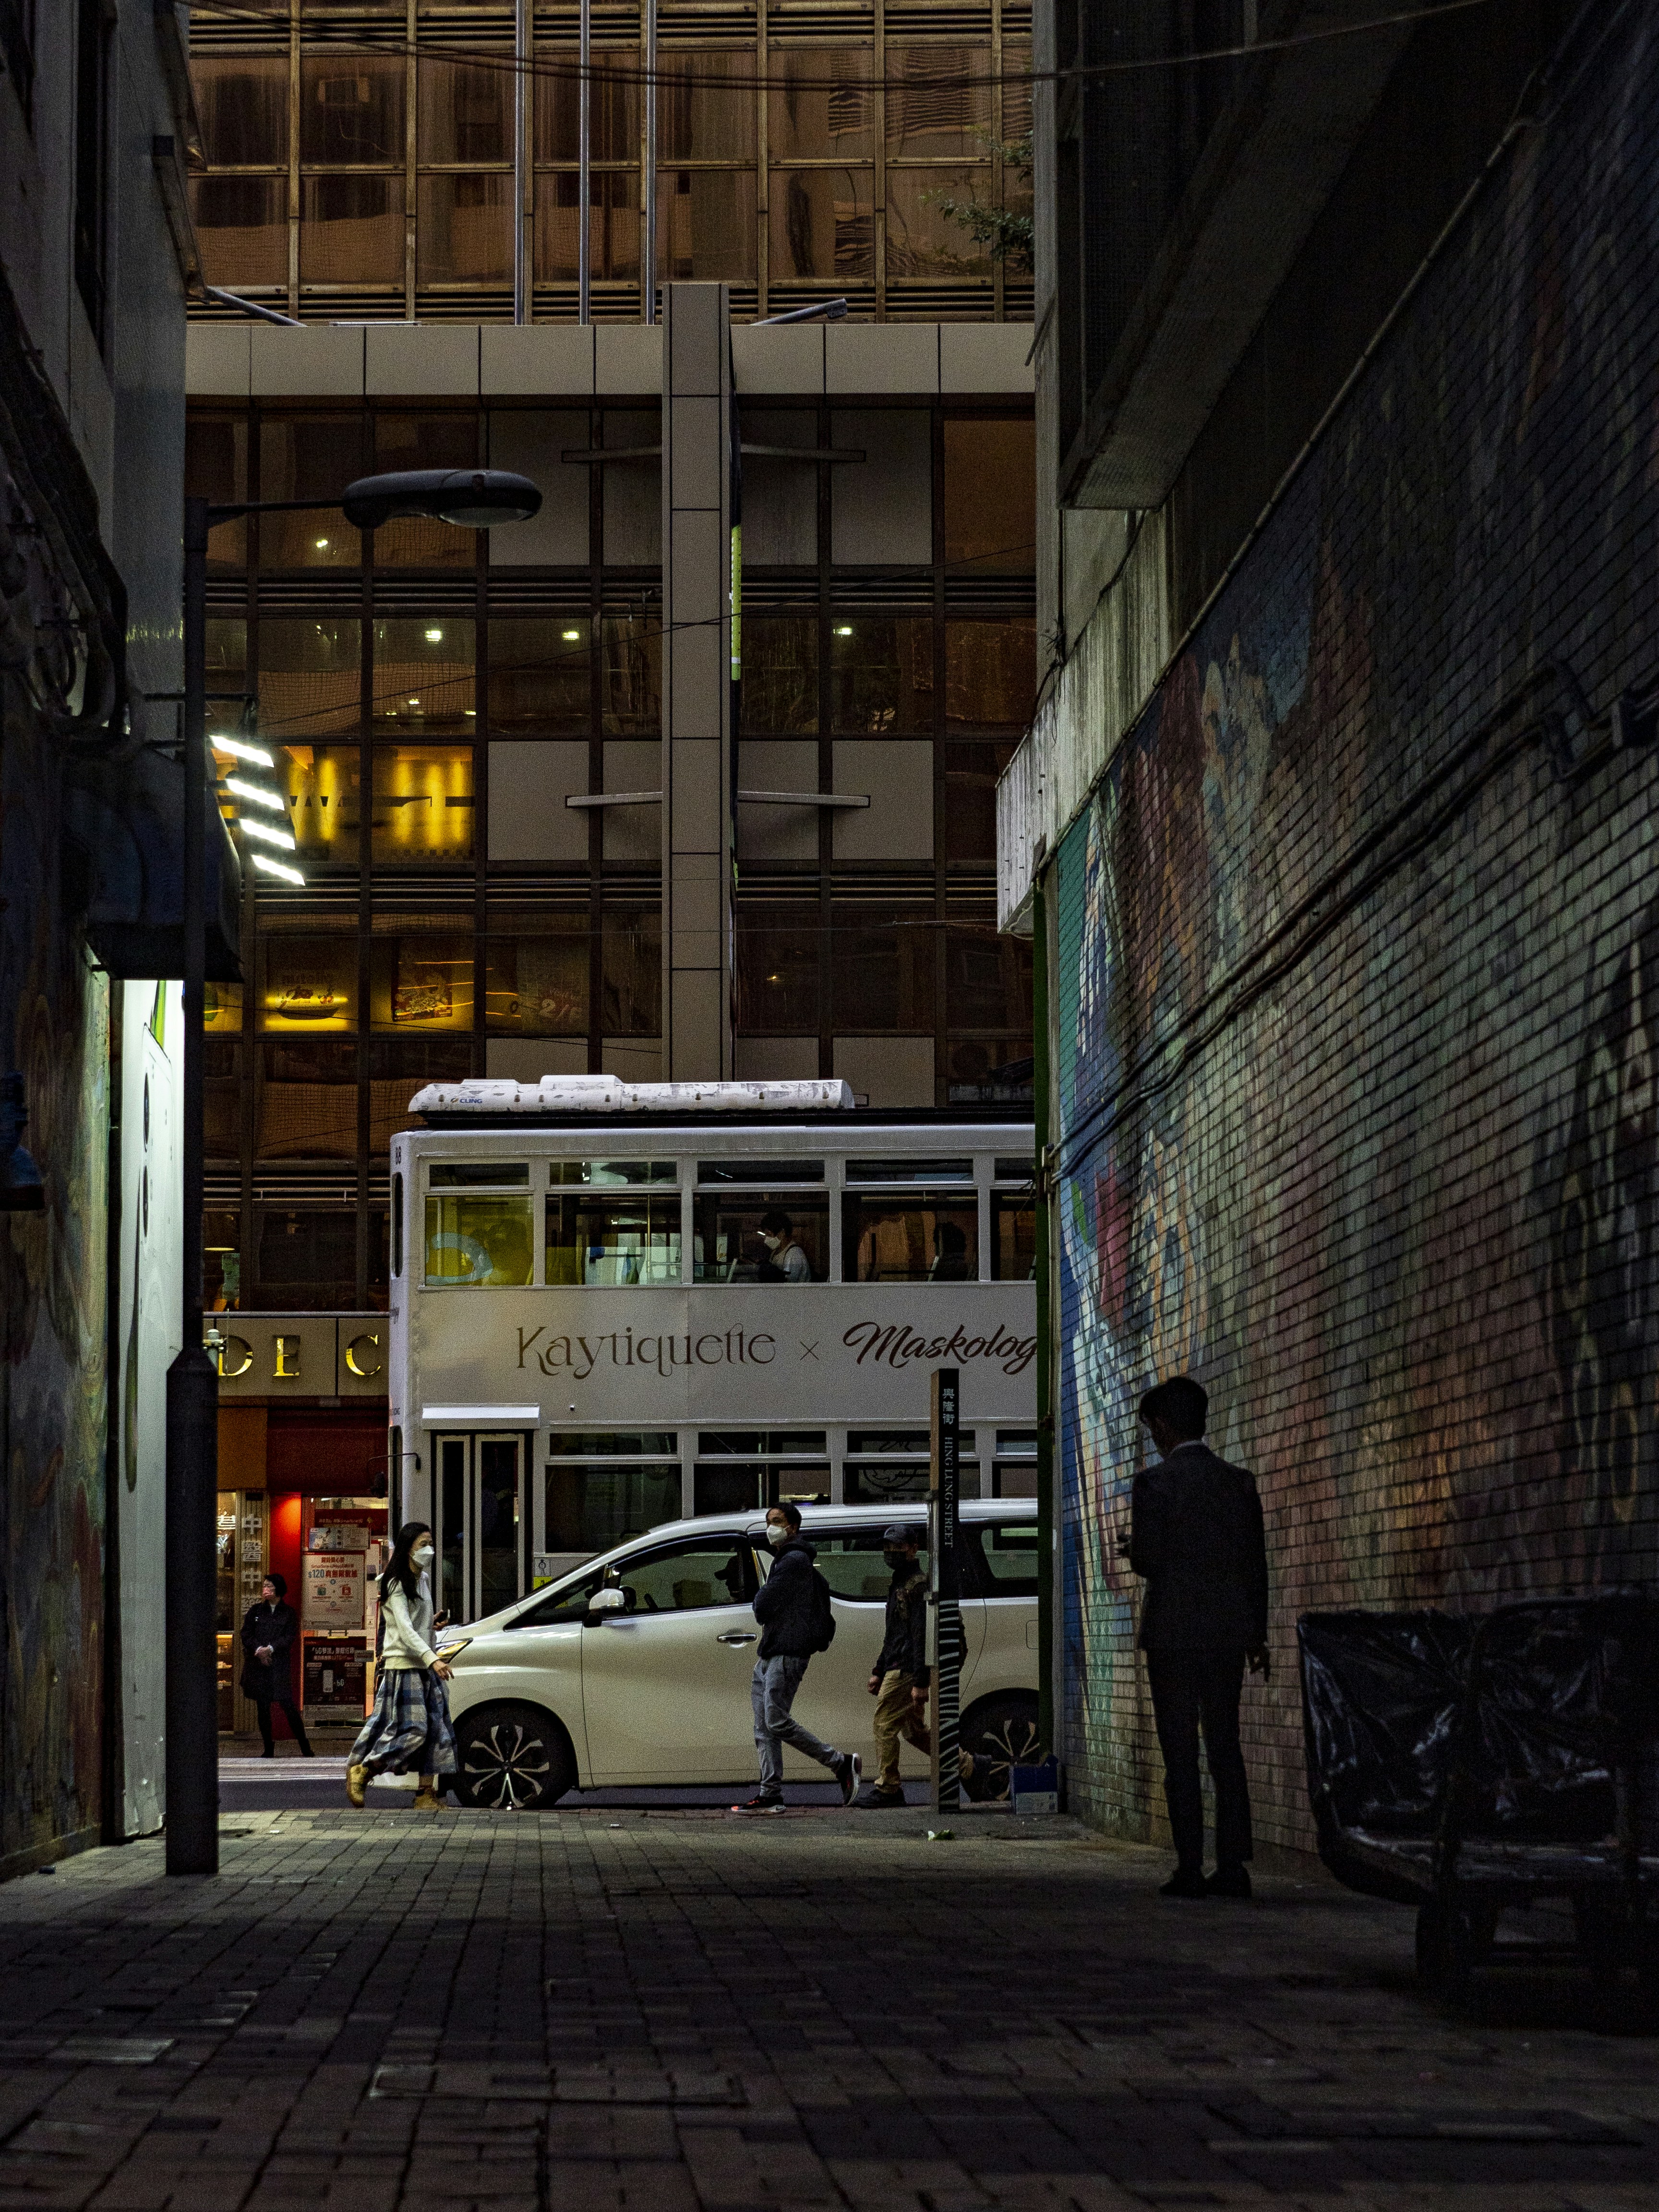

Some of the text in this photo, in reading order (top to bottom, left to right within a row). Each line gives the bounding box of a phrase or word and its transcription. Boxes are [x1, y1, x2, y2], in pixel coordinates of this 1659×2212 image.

[345, 1334, 381, 1376] C
[516, 1323, 776, 1381] Kaytiquette
[942, 1388, 955, 1425] 興隆街
[945, 1437, 953, 1548] HING LUNG STREET
